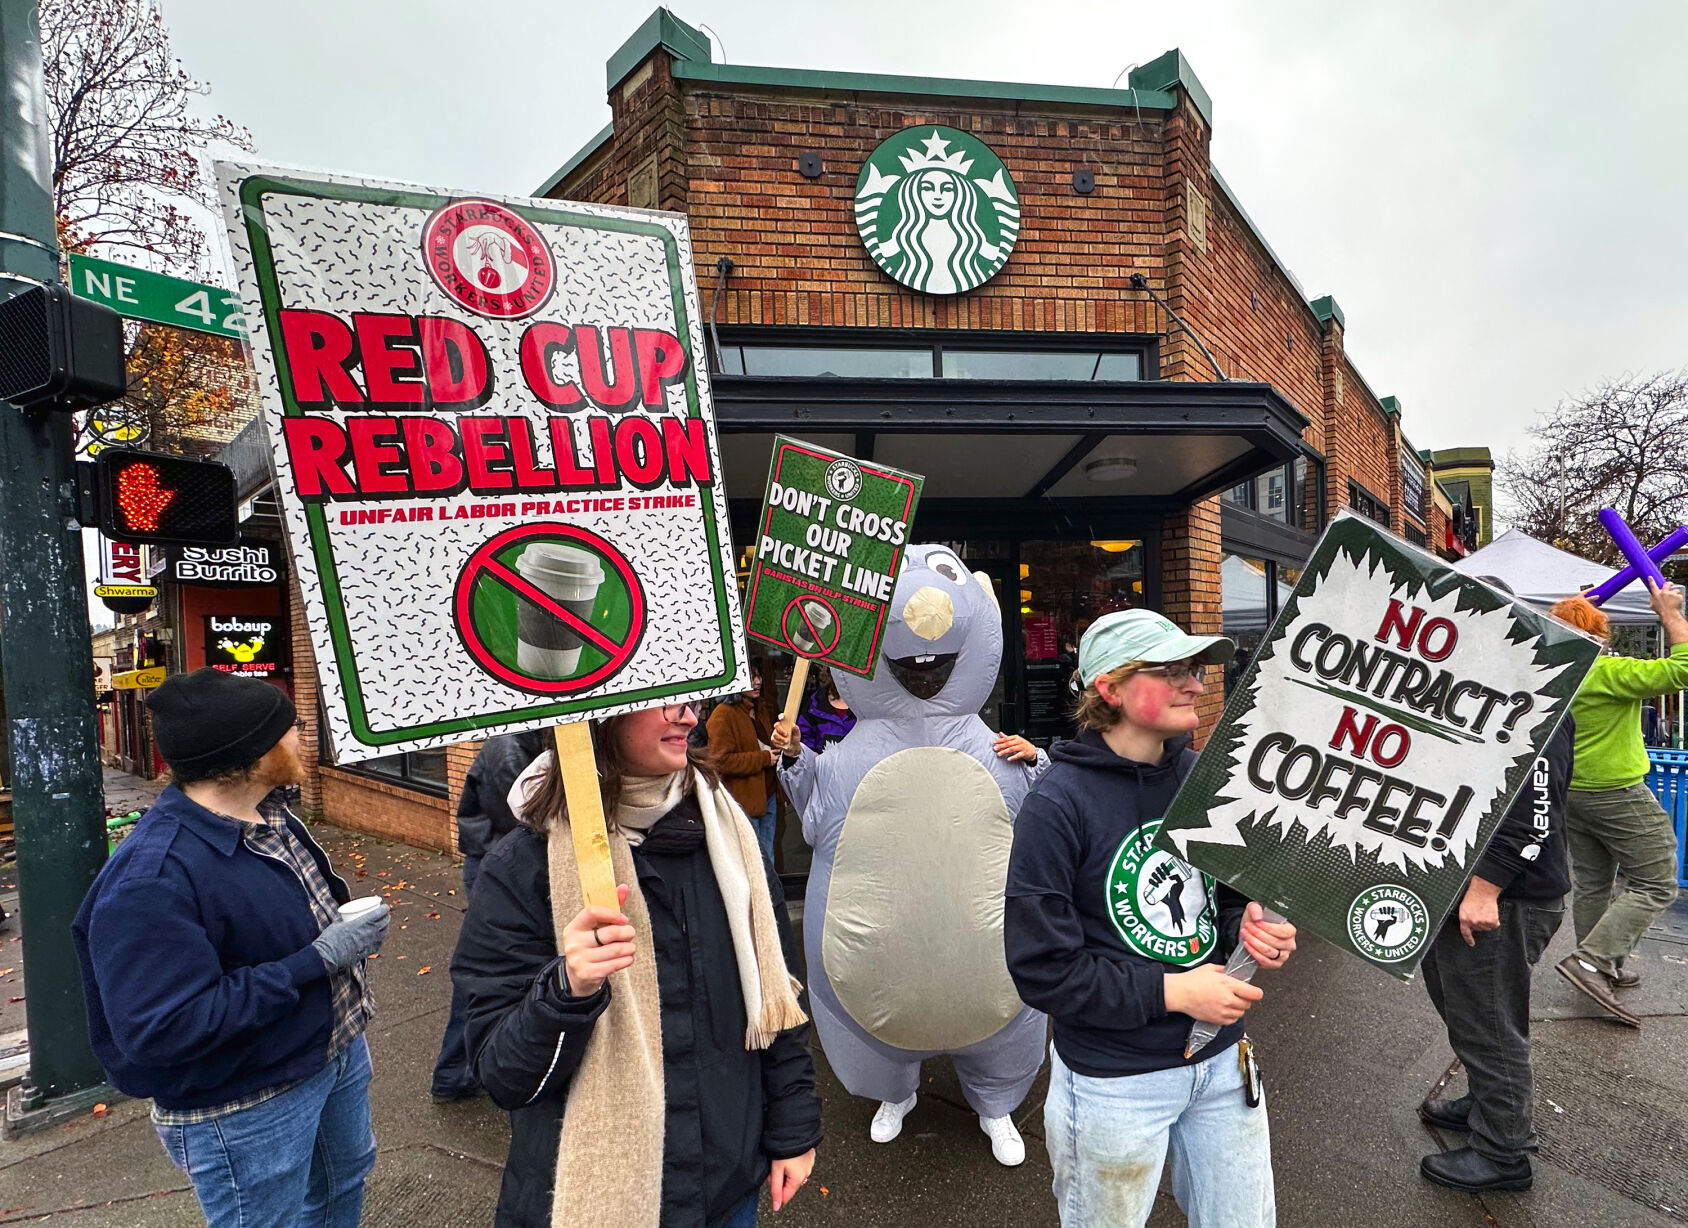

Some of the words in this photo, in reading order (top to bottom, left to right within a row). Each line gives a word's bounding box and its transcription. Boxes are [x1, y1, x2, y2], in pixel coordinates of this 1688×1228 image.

[439, 208, 535, 245] STARBUCKS
[85, 269, 139, 305] NE
[434, 246, 501, 311] WORKERS
[512, 256, 546, 309] UNITED
[278, 310, 495, 412] RED
[519, 321, 692, 413] CUP
[283, 416, 714, 502] REBELLION
[339, 506, 434, 526] UNFAIR
[438, 502, 516, 521] LABOR
[521, 497, 628, 516] PRACTICE
[628, 494, 696, 511] STRIKE
[768, 482, 832, 521] DON'T
[836, 504, 907, 546] CROSS
[112, 542, 142, 584] ERY
[183, 546, 269, 565] Sushi
[806, 523, 852, 558] OUR
[99, 586, 155, 596] Shwarma
[176, 561, 277, 582] Burrito
[758, 535, 838, 583] PICKET
[841, 563, 894, 602] LINE
[763, 567, 808, 589] BARISTAS
[807, 583, 822, 594] ON
[822, 588, 842, 600] ULP
[842, 595, 878, 613] STRIKE
[211, 616, 271, 635] bobaup
[1375, 598, 1459, 663] NO
[212, 664, 238, 672] SELF
[242, 662, 275, 671] SERVE
[1290, 622, 1535, 744] CONTRACT?
[1328, 705, 1412, 769] NO
[1247, 731, 1476, 851] COFFEE!
[1114, 898, 1188, 957] WORKERS
[1352, 906, 1375, 952] WORKERS
[1370, 888, 1425, 924] STARBUCKS
[1384, 936, 1419, 957] UNITED
